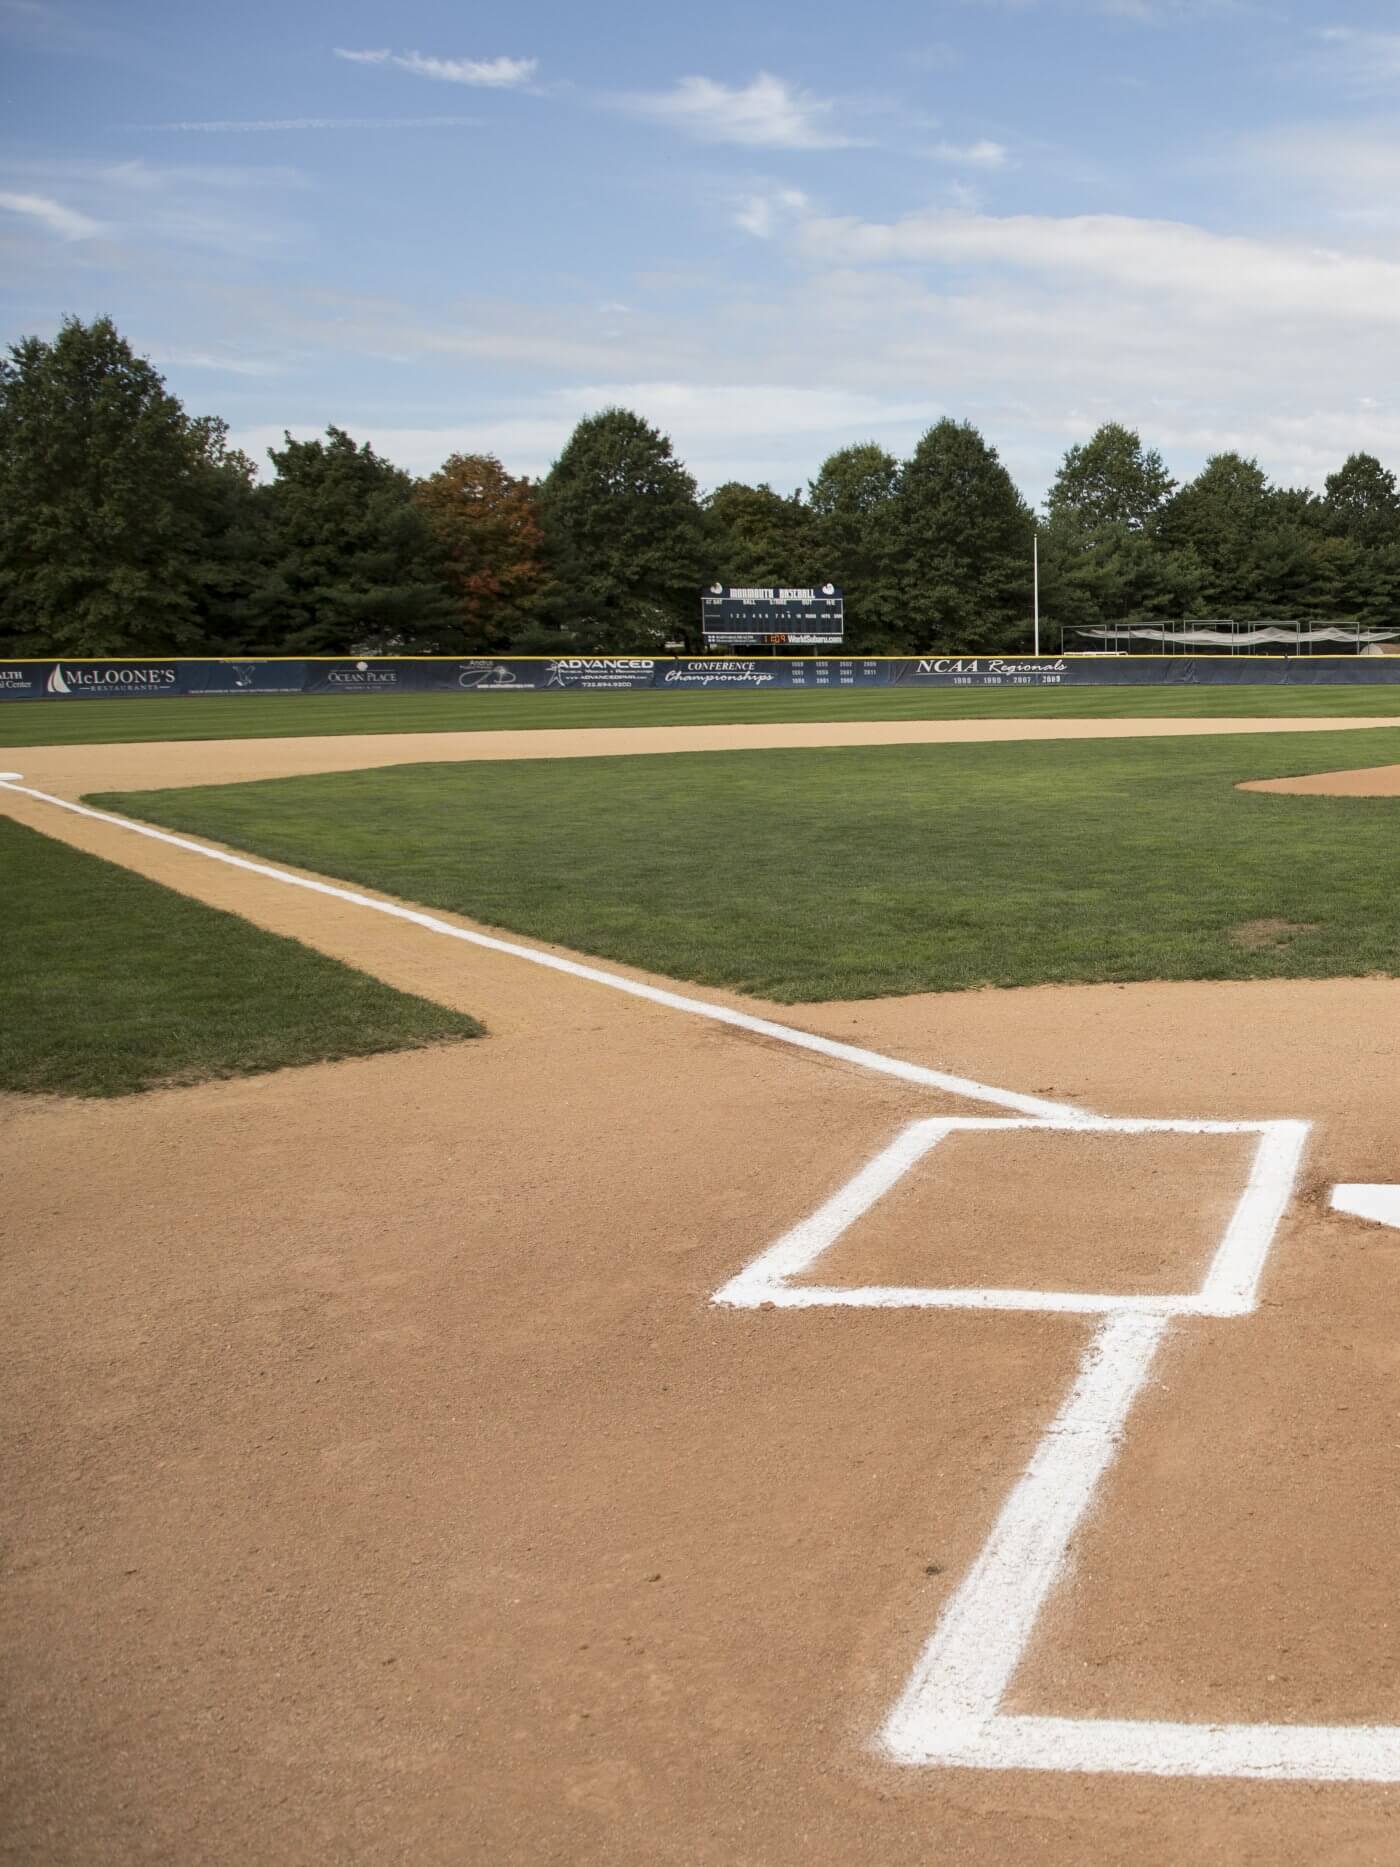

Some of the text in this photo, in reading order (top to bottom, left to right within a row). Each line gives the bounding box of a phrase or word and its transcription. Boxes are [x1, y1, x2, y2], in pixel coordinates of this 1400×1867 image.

[559, 660, 654, 668] ADVANCED
[687, 662, 756, 670] CONFERENCE
[916, 659, 1067, 676] NCAA Regionals
[66, 669, 175, 684] McLOONE'S
[328, 672, 397, 681] OCEAN PLACE
[665, 670, 775, 686] Championships
